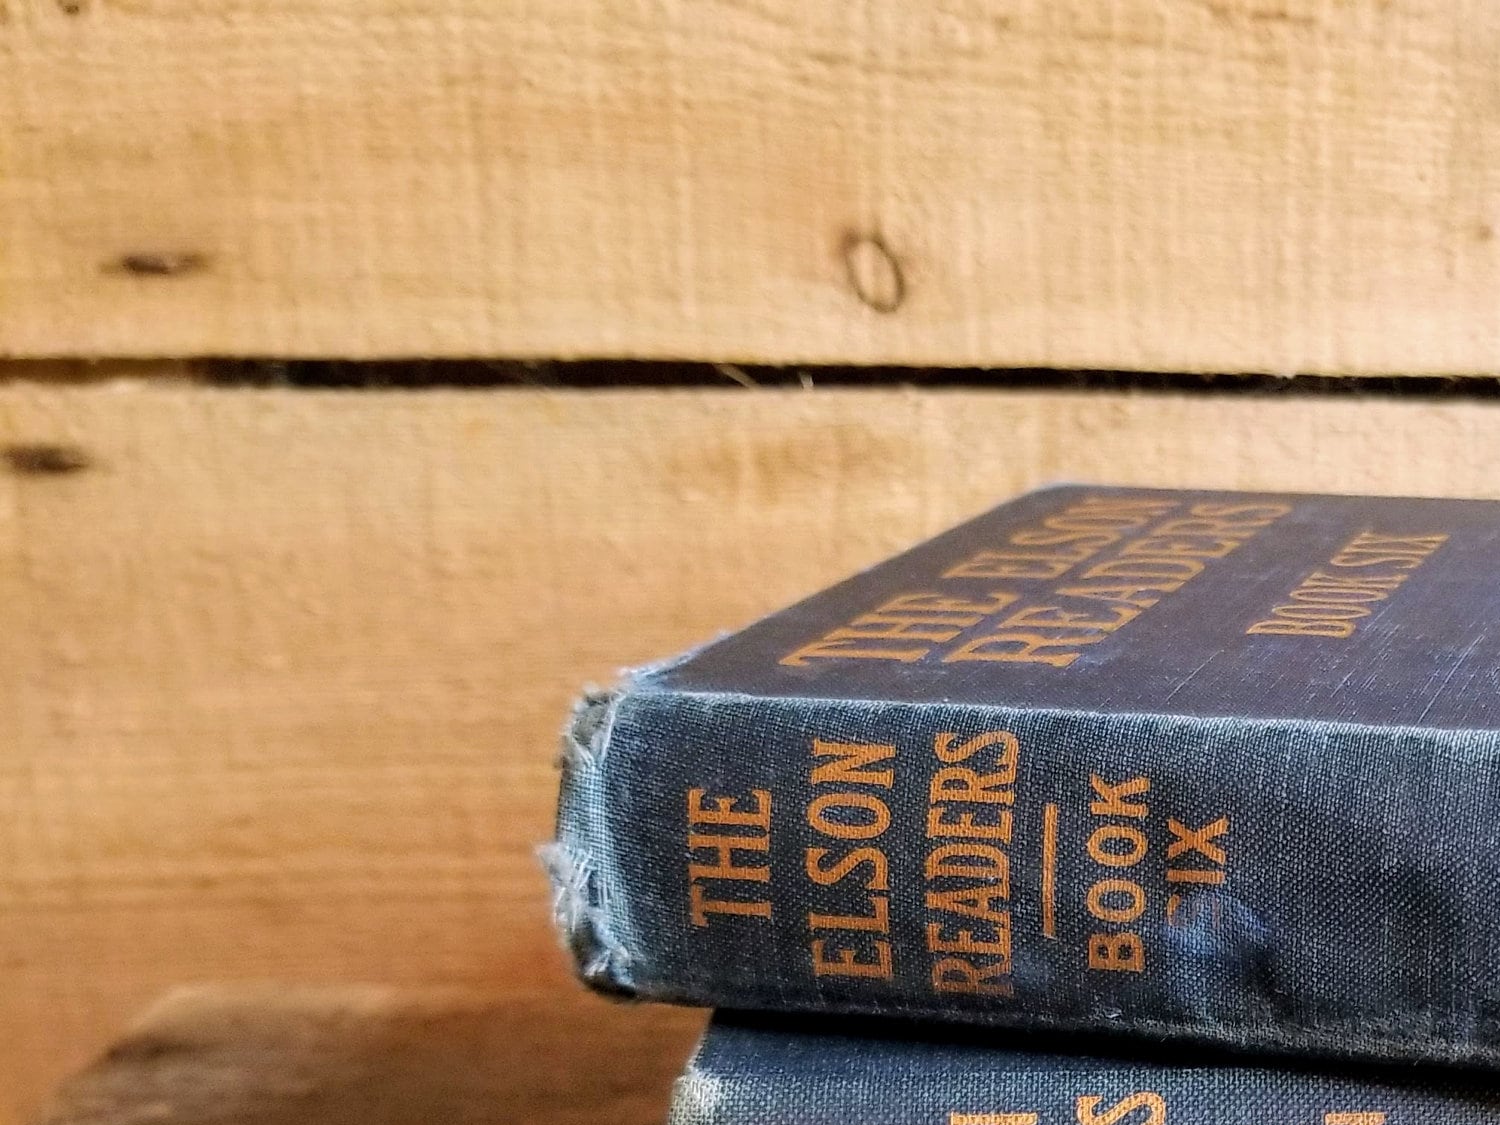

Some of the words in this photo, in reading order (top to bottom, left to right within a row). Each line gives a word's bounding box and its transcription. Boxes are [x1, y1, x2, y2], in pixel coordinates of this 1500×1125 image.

[778, 592, 1019, 667] THE
[941, 498, 1182, 580] ELSON
[942, 502, 1294, 667] READERS
[1246, 571, 1412, 638] BOOK
[1336, 530, 1451, 570] SIX
[687, 788, 772, 928] THE
[807, 738, 898, 981] ELSON
[924, 730, 1021, 998] READERS
[1085, 774, 1151, 974] BOOK
